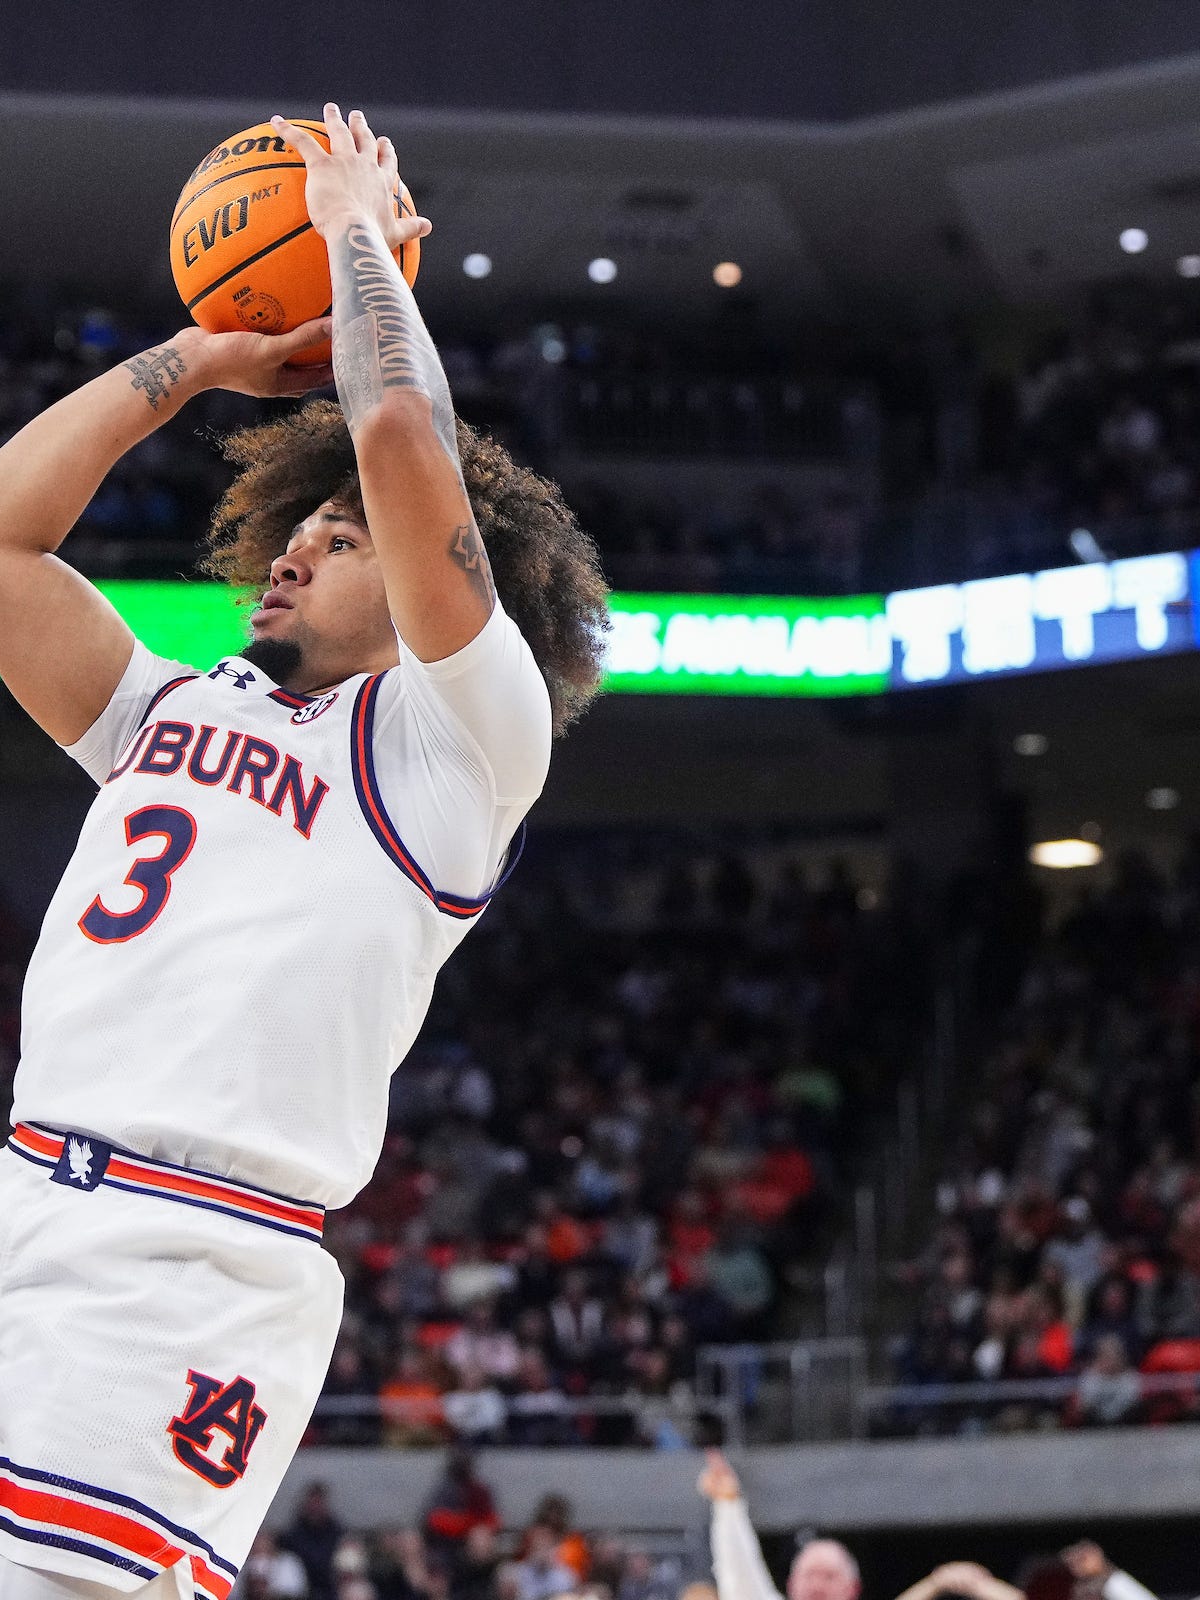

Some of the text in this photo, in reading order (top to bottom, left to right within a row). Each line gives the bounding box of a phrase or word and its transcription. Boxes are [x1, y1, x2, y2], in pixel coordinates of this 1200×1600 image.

[183, 183, 282, 269] EVO NXT
[105, 720, 329, 840] UBURN
[77, 804, 197, 944] 3
